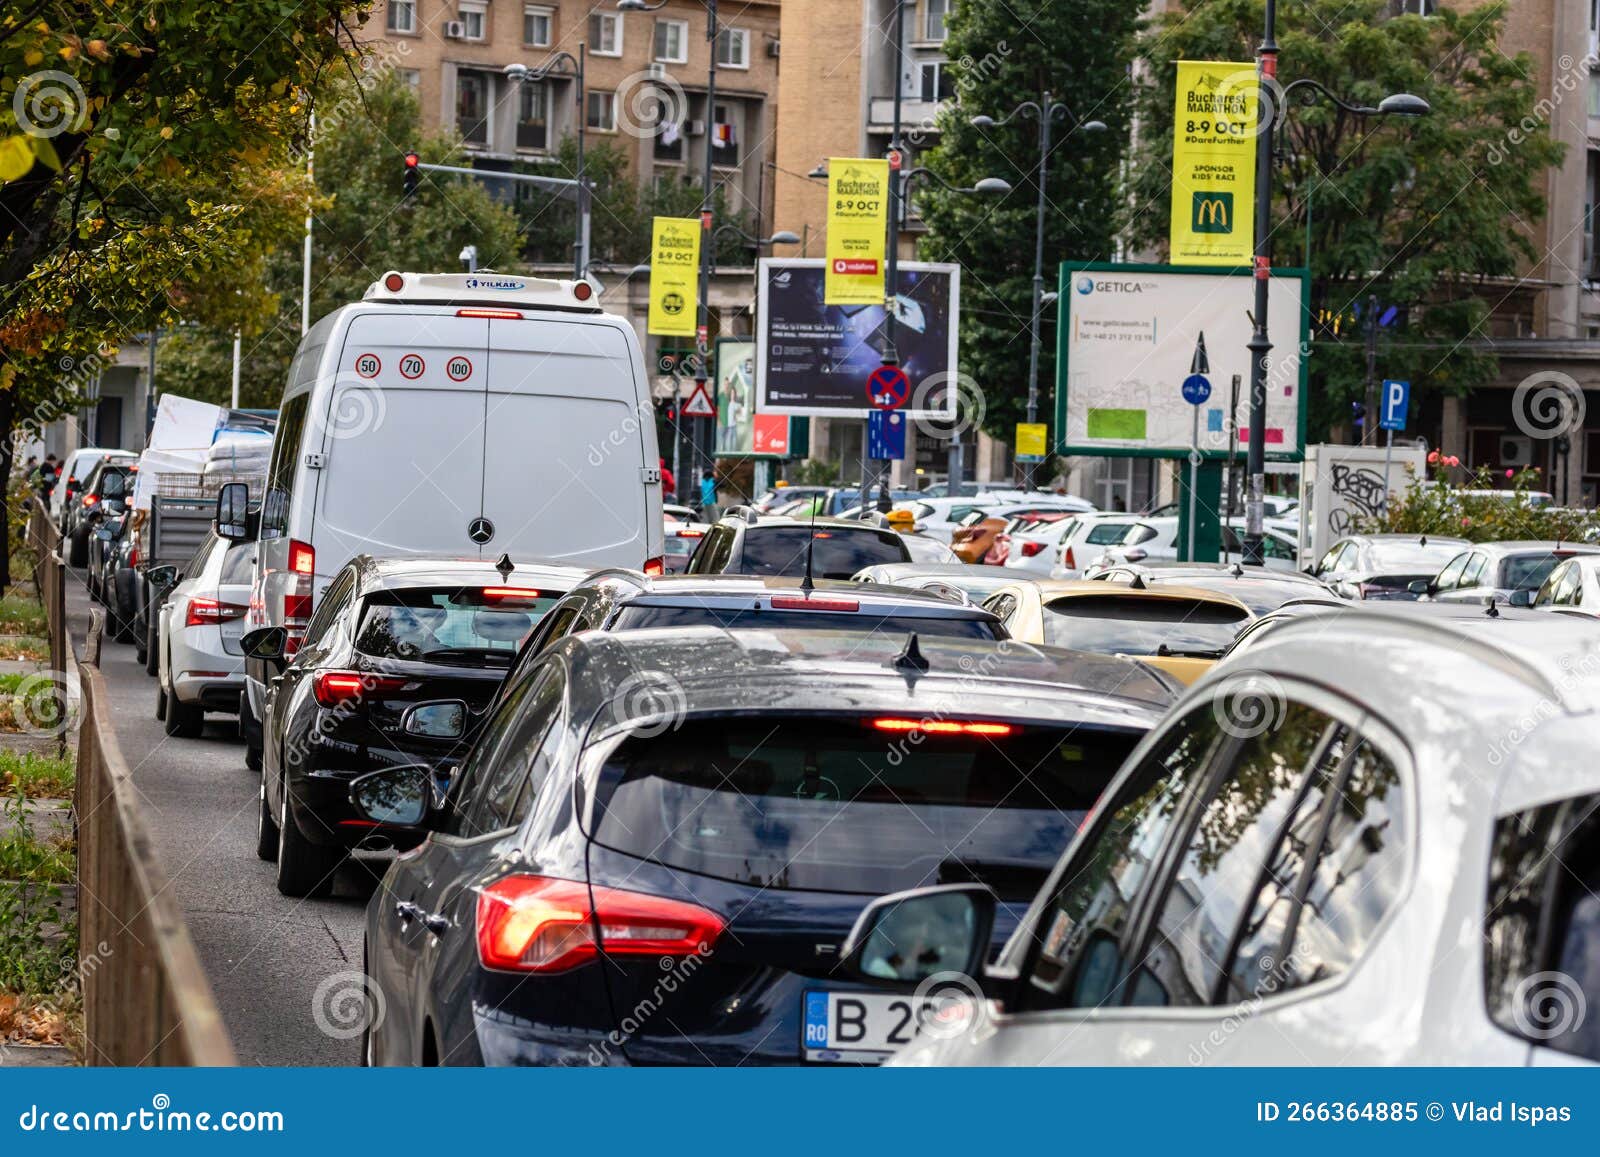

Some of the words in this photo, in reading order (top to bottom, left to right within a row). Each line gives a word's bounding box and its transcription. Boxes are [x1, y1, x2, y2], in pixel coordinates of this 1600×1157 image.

[1187, 91, 1246, 104] Bucharest
[1187, 103, 1246, 114] MARATHON
[1186, 120, 1210, 133] 8-9
[1215, 121, 1247, 134] OCT
[1185, 136, 1245, 144] #DareFurther
[836, 200, 854, 209] 8-9
[857, 201, 880, 210] OCT
[1096, 281, 1142, 293] GETICA
[361, 360, 376, 372] 50
[405, 360, 421, 373] 70
[451, 363, 468, 375] 100
[1388, 383, 1404, 421] P
[835, 999, 867, 1043] B
[807, 1024, 826, 1041] RO
